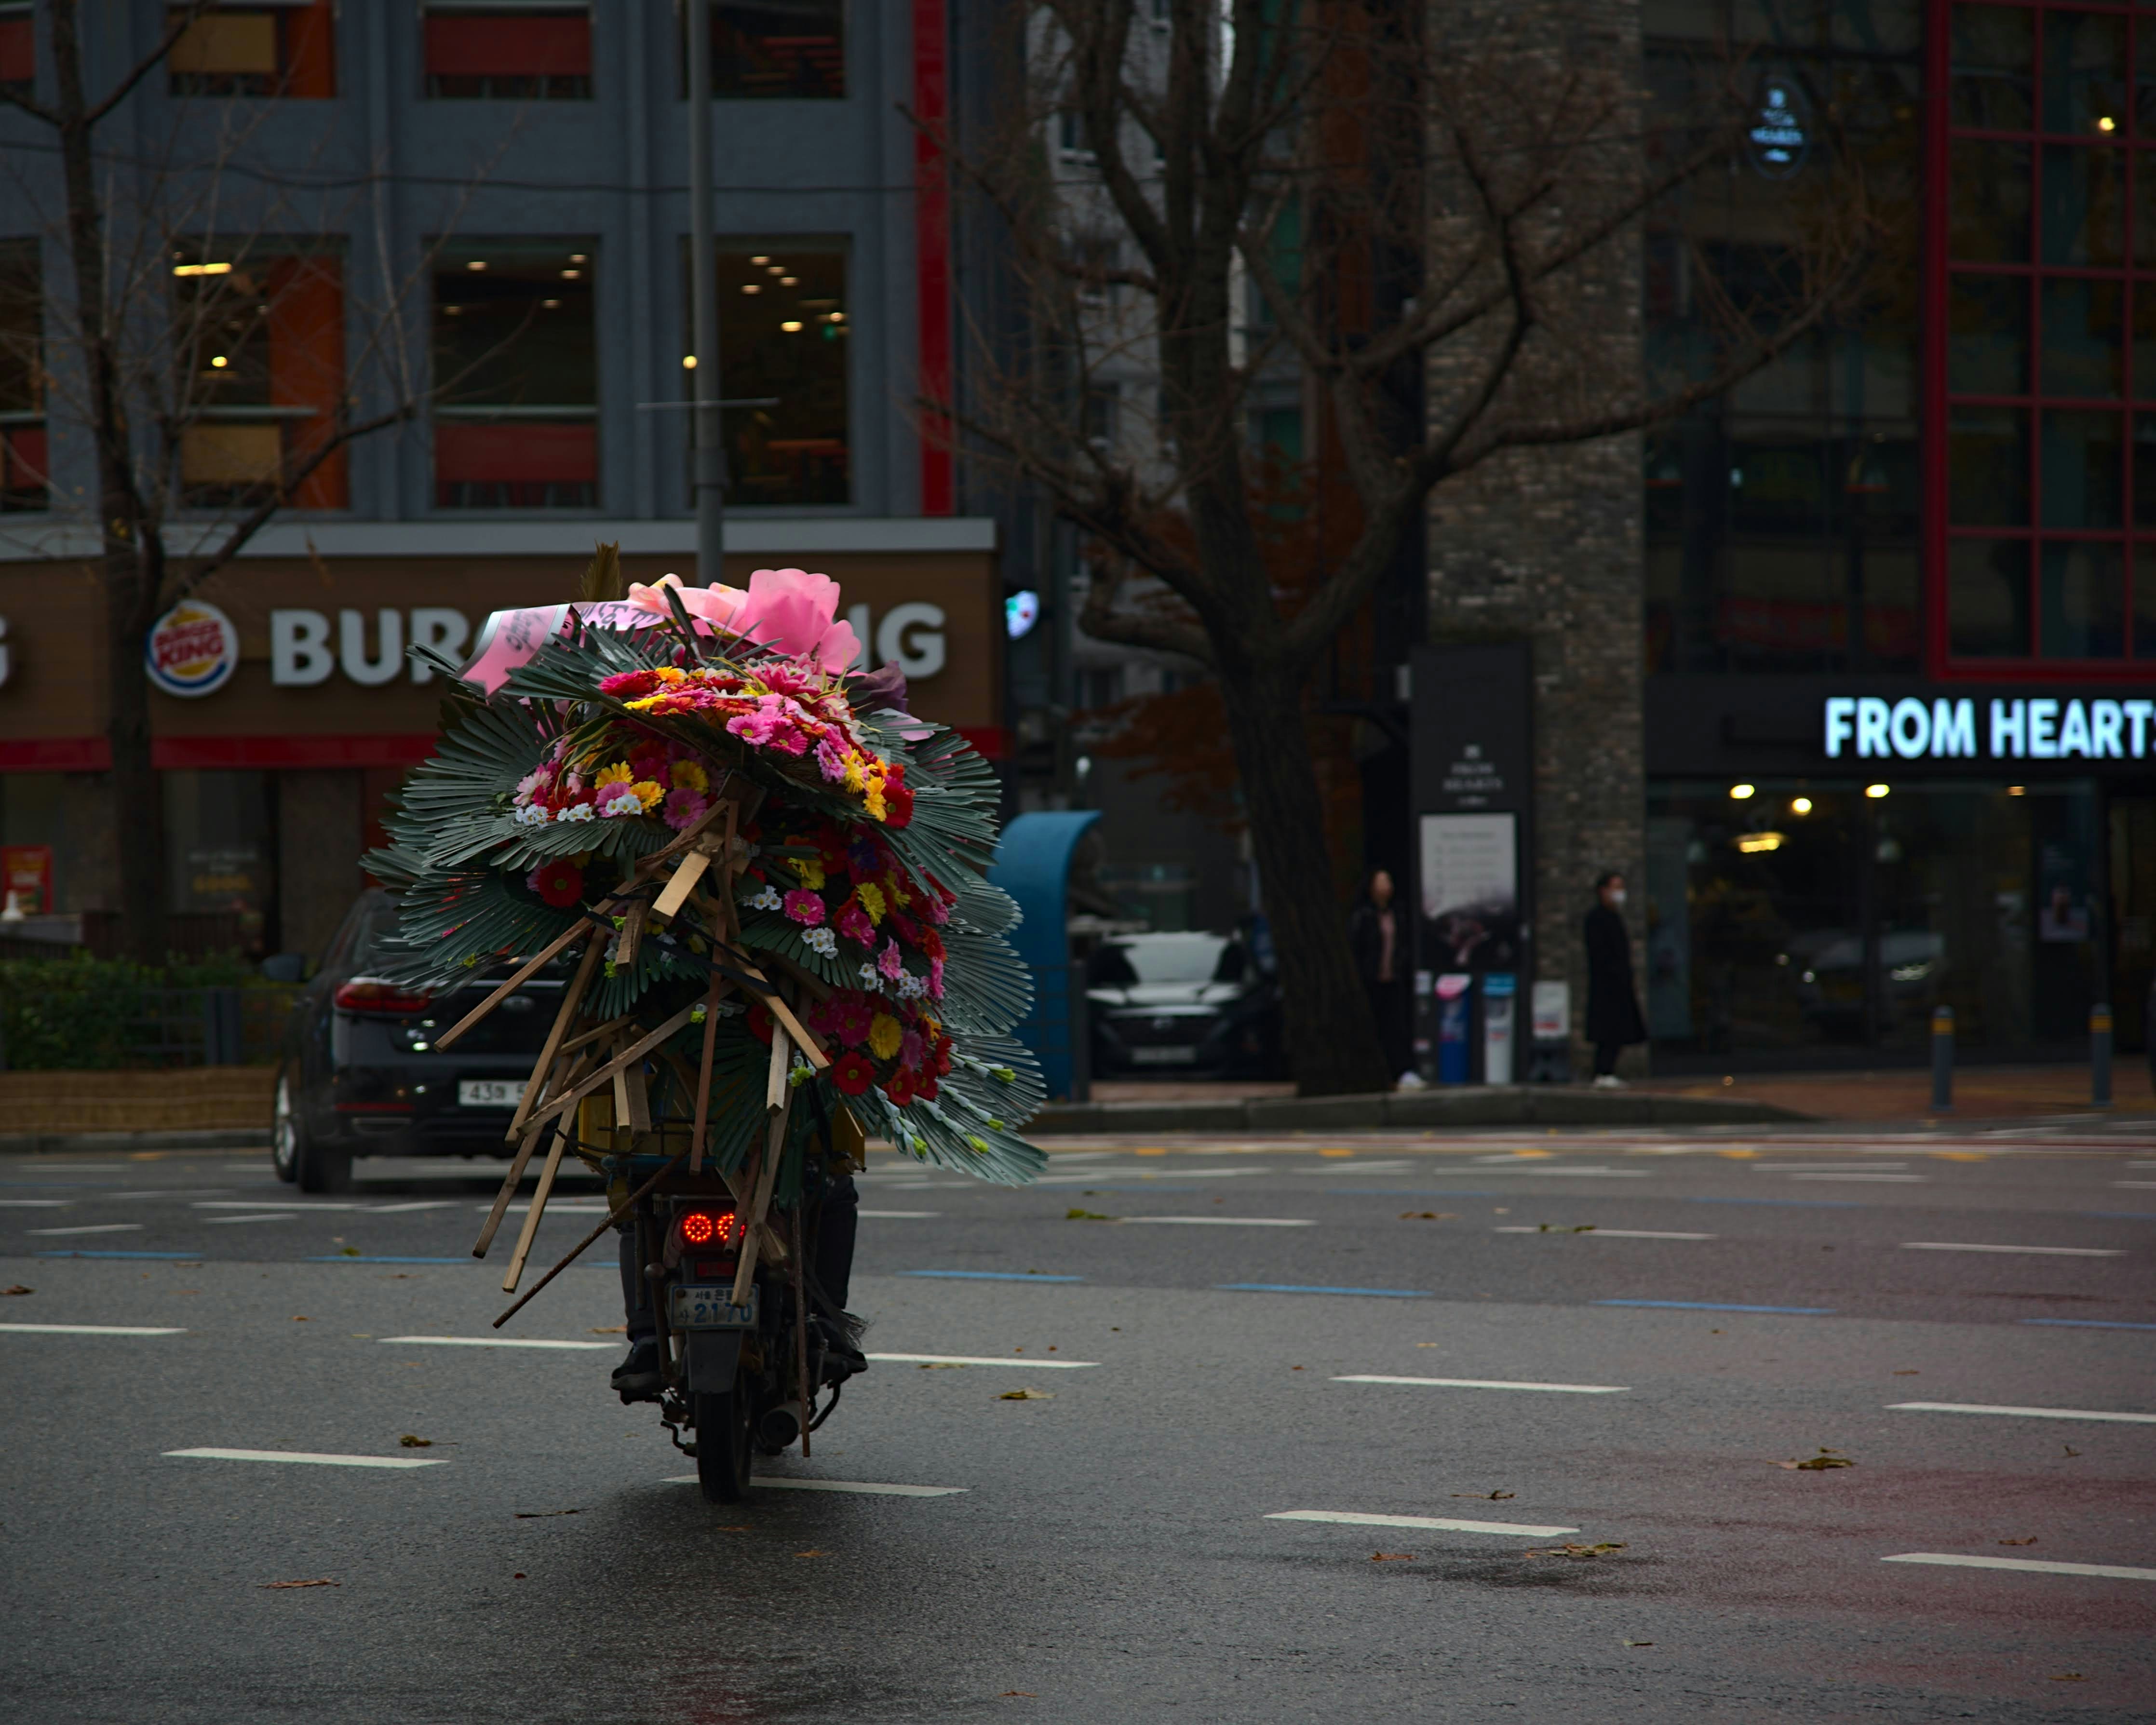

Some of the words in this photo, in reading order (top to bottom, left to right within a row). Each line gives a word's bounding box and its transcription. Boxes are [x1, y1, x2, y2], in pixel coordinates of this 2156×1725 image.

[157, 634, 223, 672] KING
[1824, 696, 1976, 759] FROM
[1990, 698, 2156, 760] HEART
[694, 1303, 752, 1323] 2170
